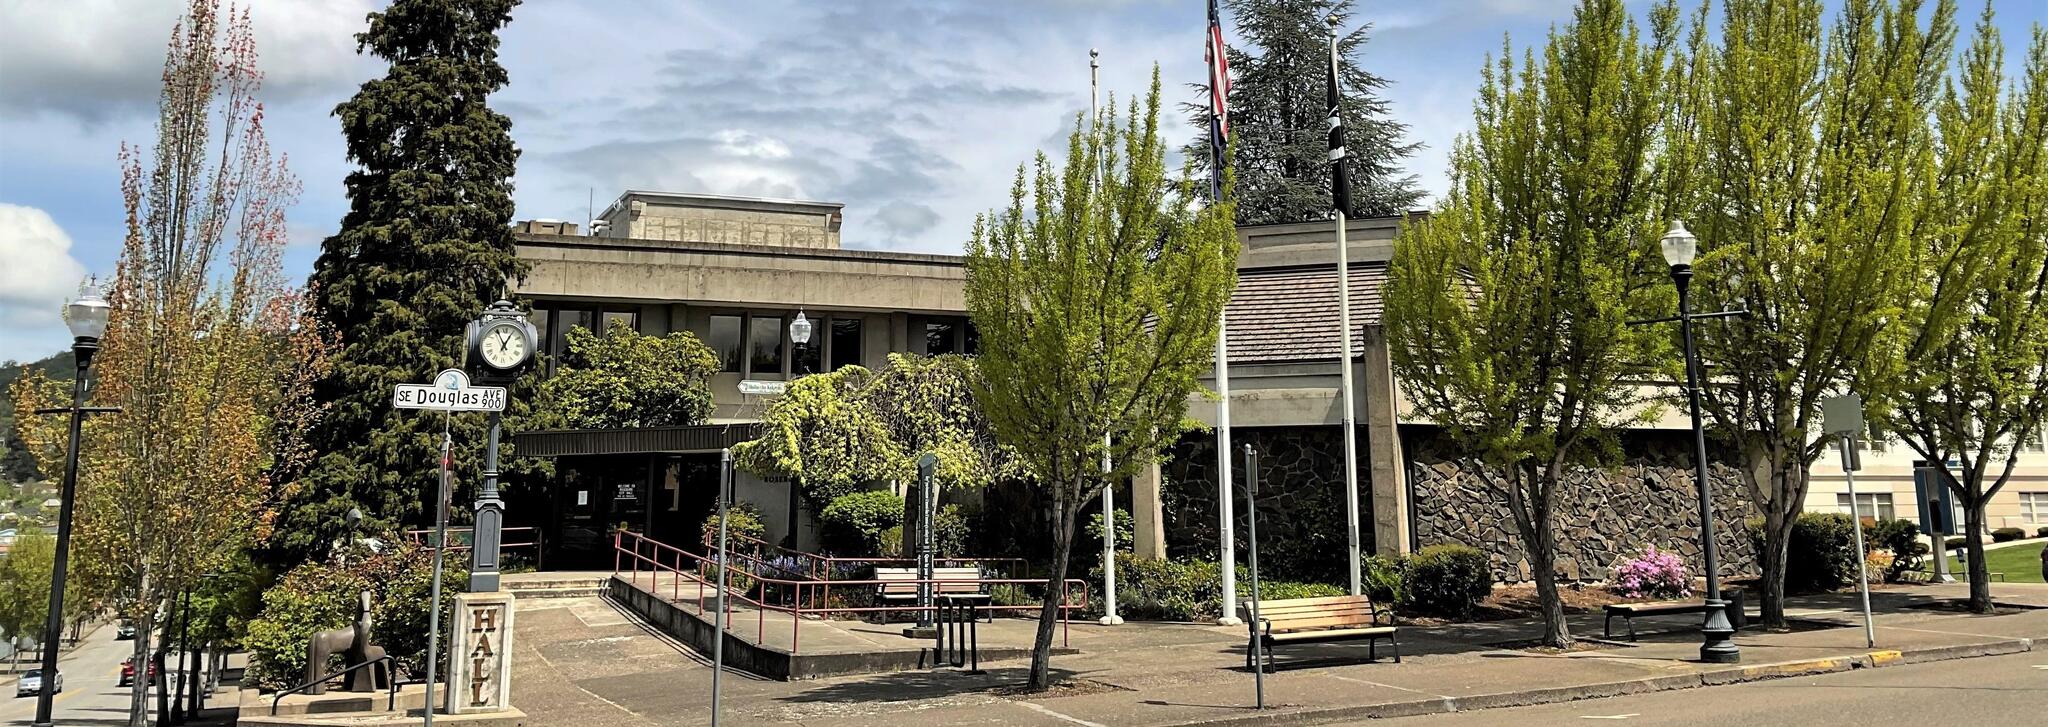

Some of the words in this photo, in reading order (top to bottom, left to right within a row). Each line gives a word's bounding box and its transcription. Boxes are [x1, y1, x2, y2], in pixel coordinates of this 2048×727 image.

[398, 390, 412, 402] SE
[417, 389, 479, 407] Douglas
[482, 389, 502, 399] AVE
[481, 399, 501, 409] 900
[471, 609, 497, 707] HALL
